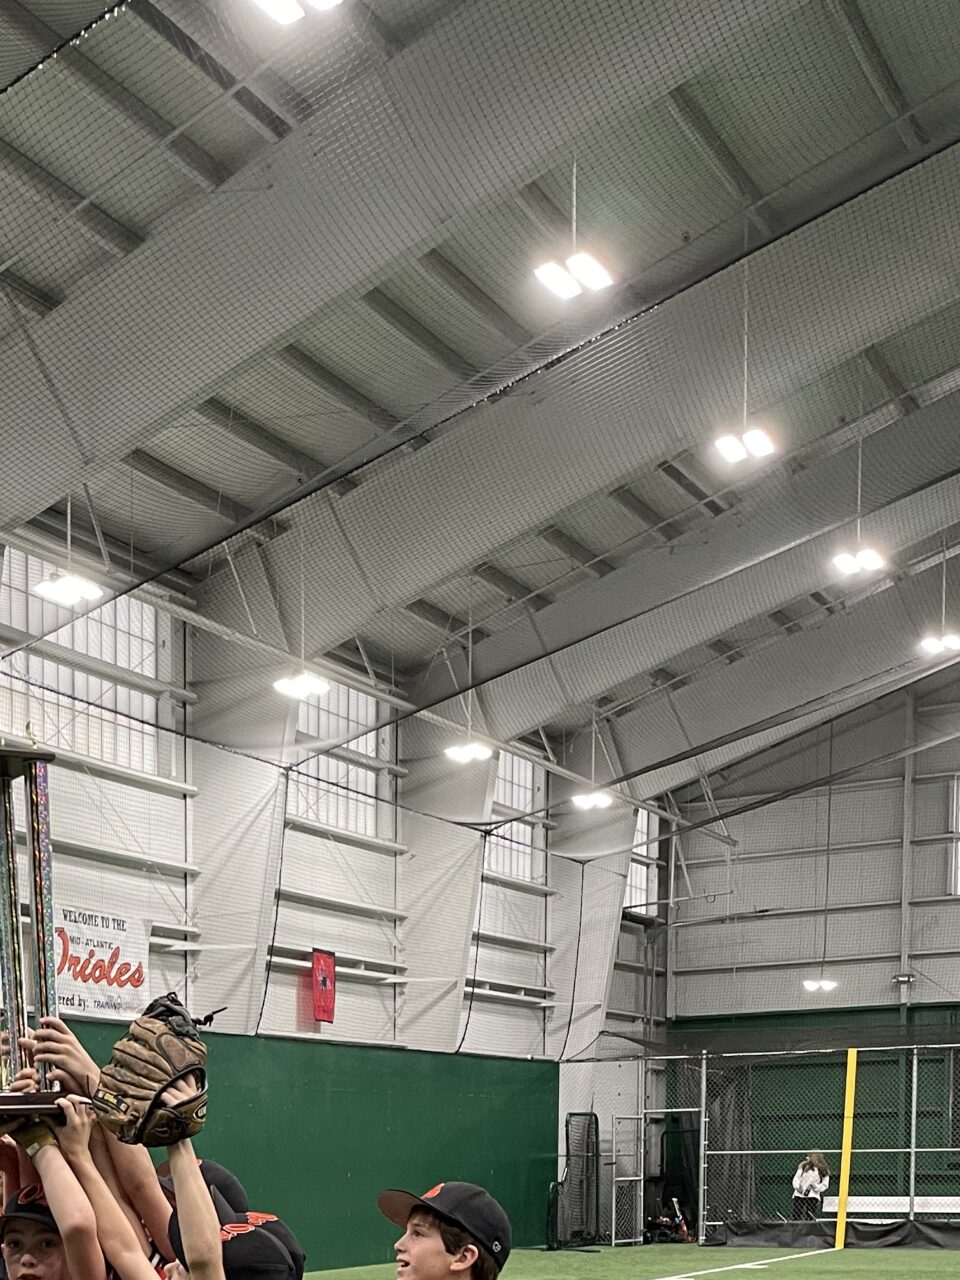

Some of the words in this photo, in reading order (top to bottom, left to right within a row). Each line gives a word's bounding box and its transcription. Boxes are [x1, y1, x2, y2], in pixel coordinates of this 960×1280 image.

[62, 908, 99, 926] WELCOME
[100, 916, 110, 929] TO
[112, 918, 127, 932] THE
